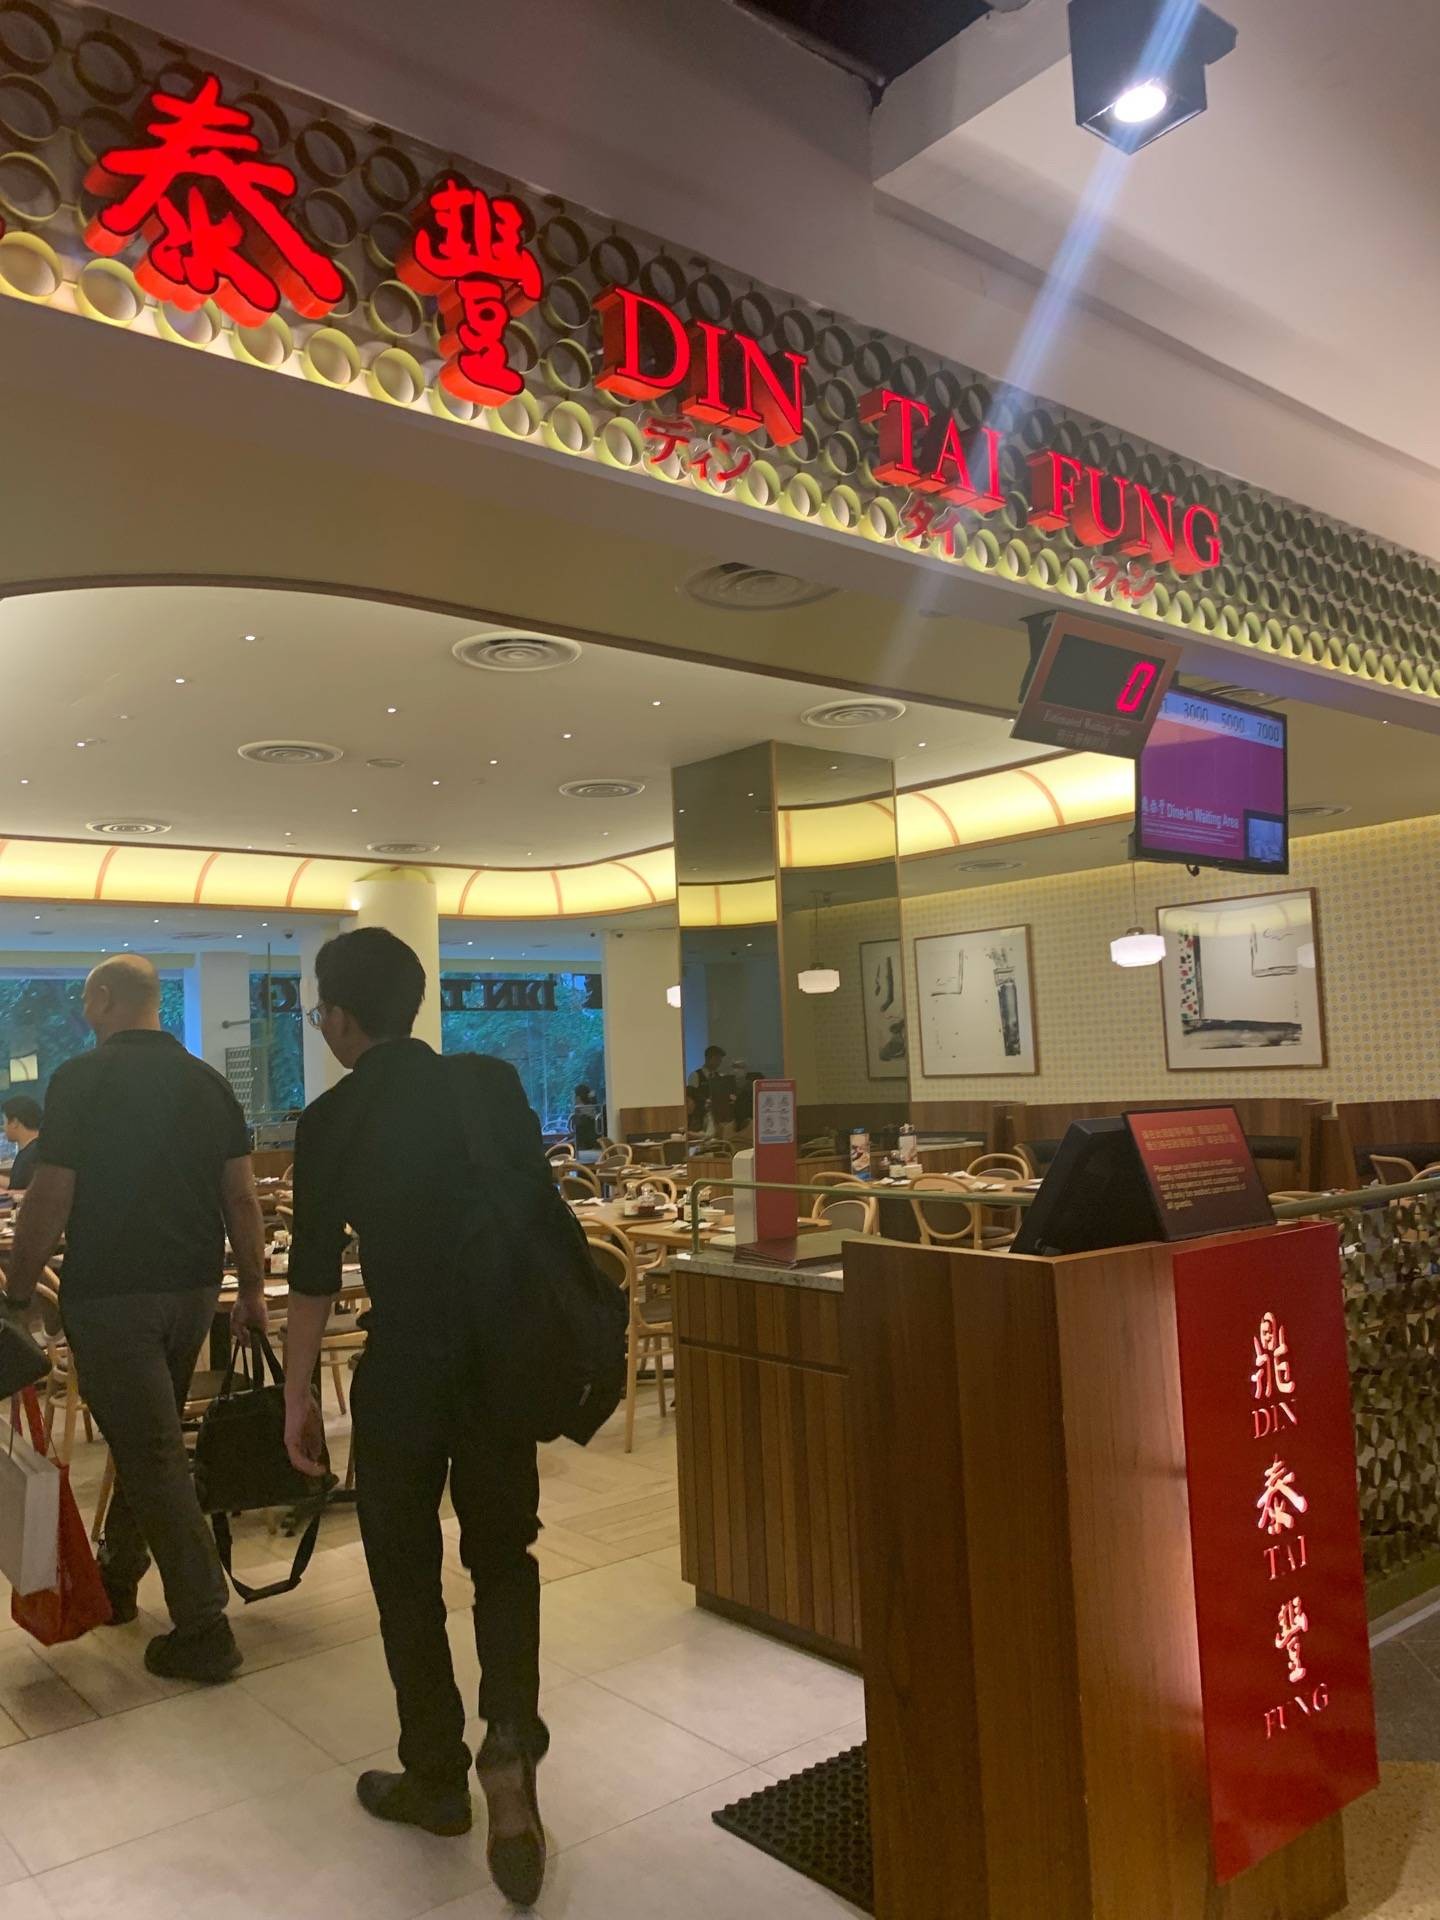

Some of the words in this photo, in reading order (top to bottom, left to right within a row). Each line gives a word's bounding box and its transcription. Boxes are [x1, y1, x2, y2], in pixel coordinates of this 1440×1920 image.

[597, 286, 809, 446] DIN
[866, 387, 1007, 513] TAI
[1034, 449, 1223, 574] FUNG
[1116, 660, 1157, 713] 0
[1183, 701, 1209, 724] 3000
[1221, 711, 1246, 733] 5000
[1256, 720, 1280, 742] 7000
[1250, 1311, 1296, 1400] 鼎
[1256, 1453, 1309, 1536] 泰
